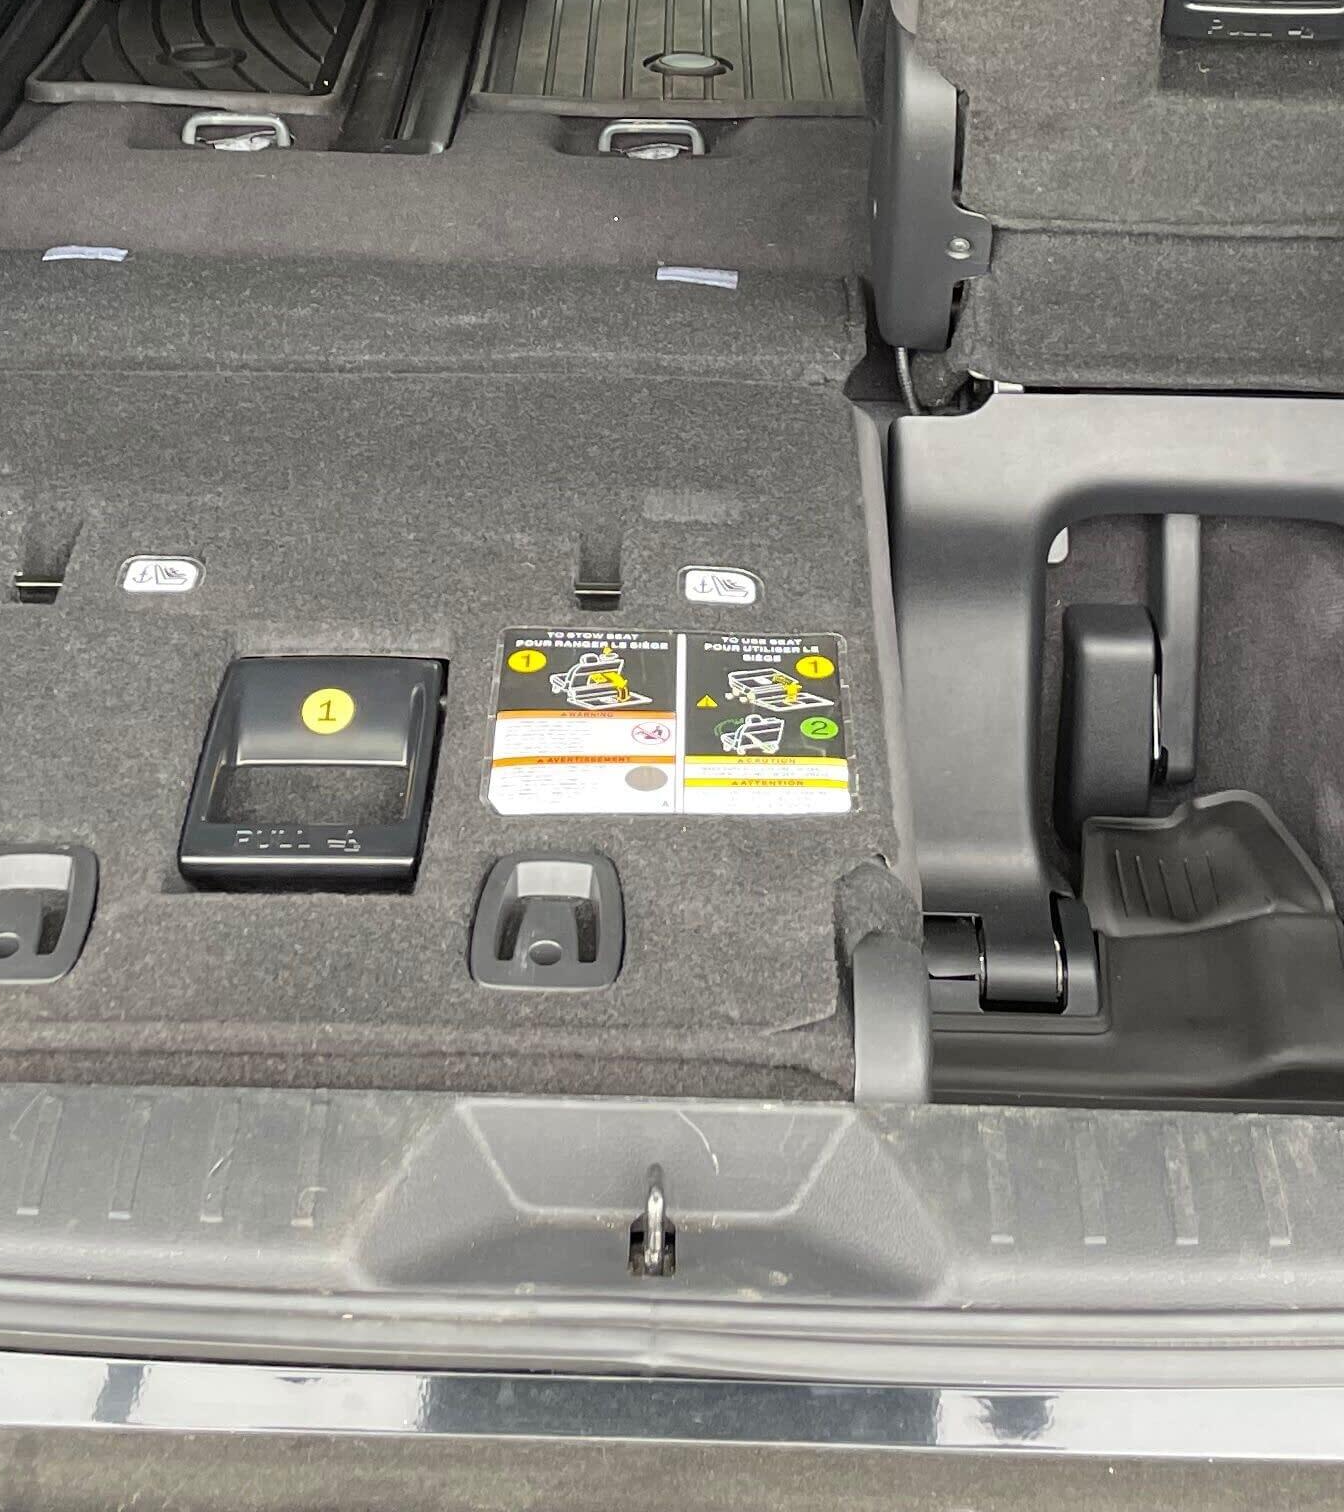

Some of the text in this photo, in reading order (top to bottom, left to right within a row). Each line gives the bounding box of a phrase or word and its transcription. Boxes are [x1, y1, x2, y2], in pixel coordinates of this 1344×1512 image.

[547, 631, 564, 639] TO
[515, 639, 553, 648] POUR
[721, 637, 739, 645] TO
[704, 643, 741, 652] POUR
[317, 699, 337, 722] 1
[809, 720, 830, 736] 2
